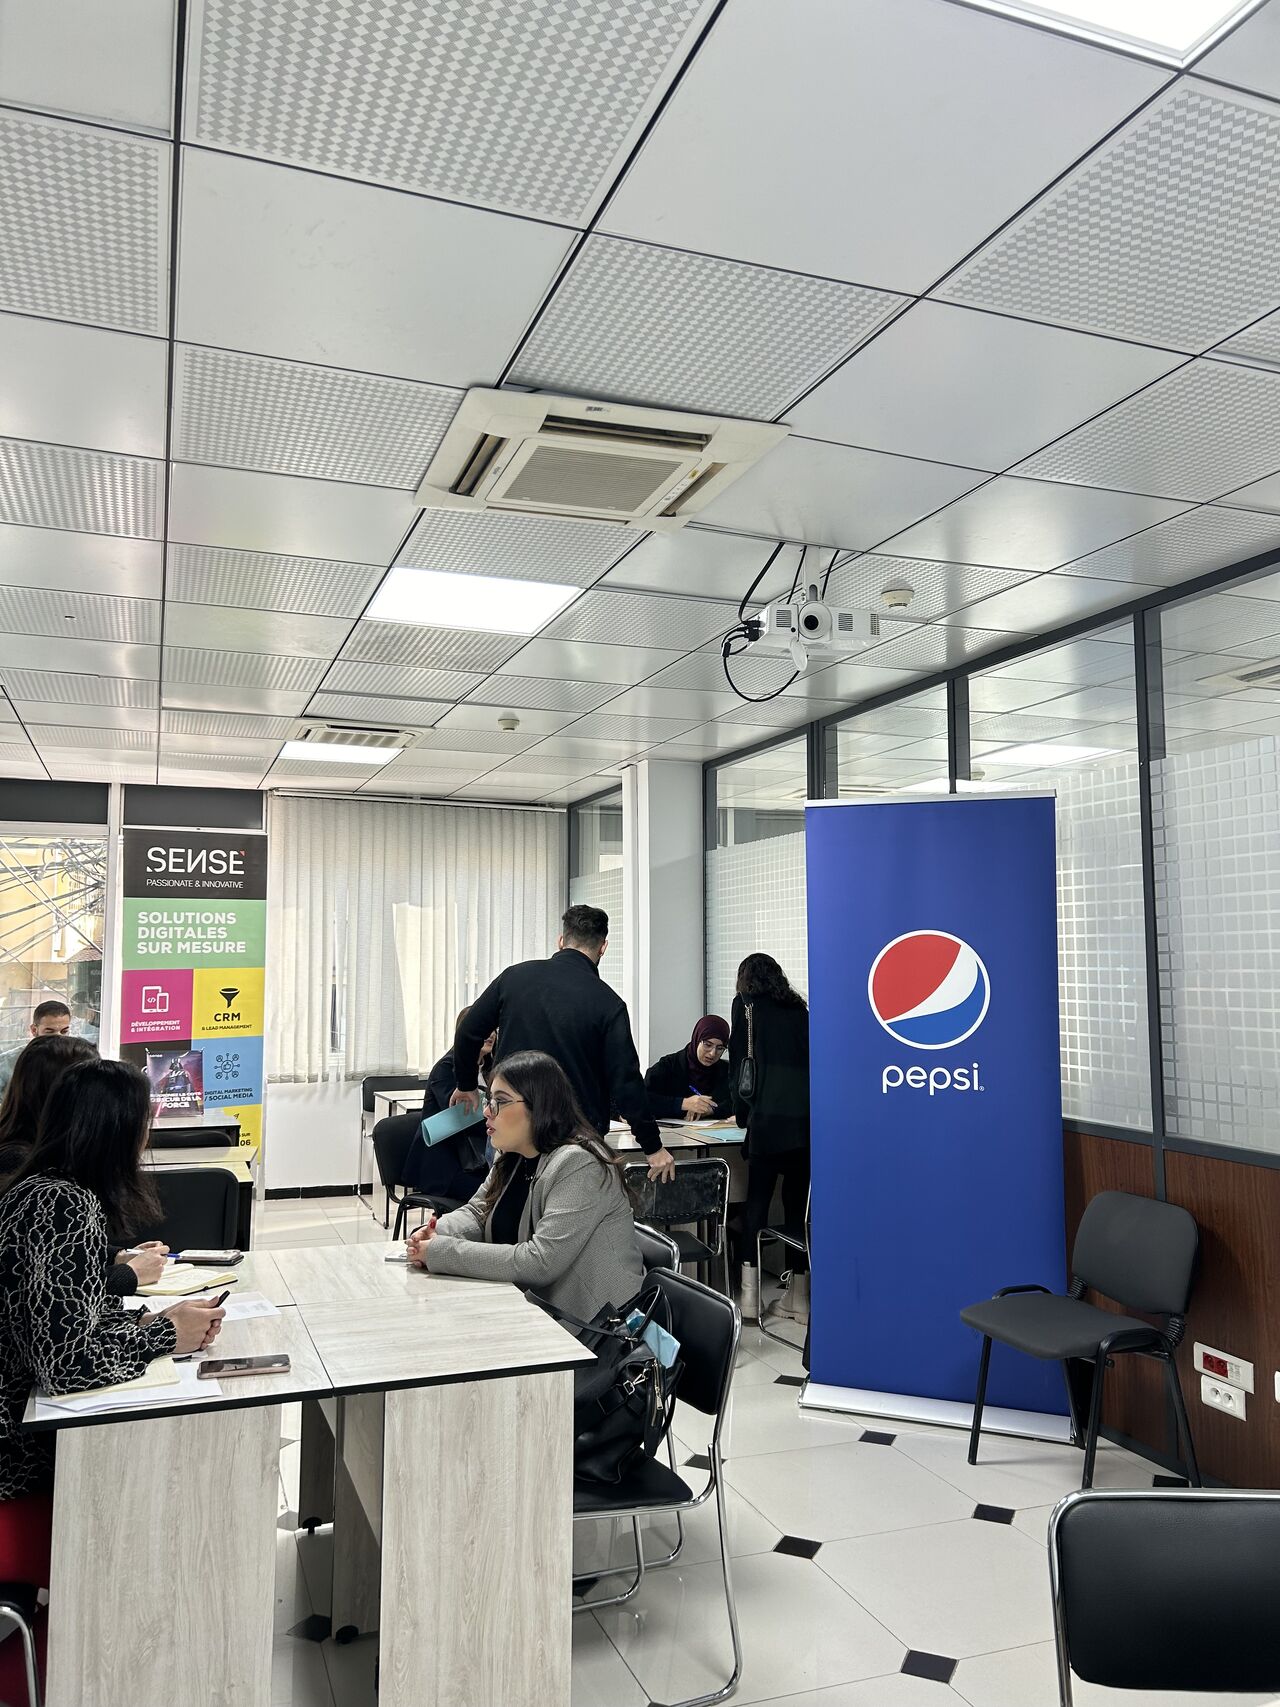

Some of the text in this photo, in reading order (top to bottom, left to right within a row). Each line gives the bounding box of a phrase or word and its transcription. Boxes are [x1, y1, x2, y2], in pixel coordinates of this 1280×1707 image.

[146, 847, 245, 875] SENSE
[146, 879, 193, 888] PASSIONATE
[202, 880, 244, 889] INNOVATIVE
[137, 911, 236, 924] SOLUTIONS
[137, 926, 228, 939] DIGITALES
[137, 941, 246, 954] SUR MESURE
[213, 1012, 241, 1022] CRM
[882, 1062, 979, 1096] pepsi
